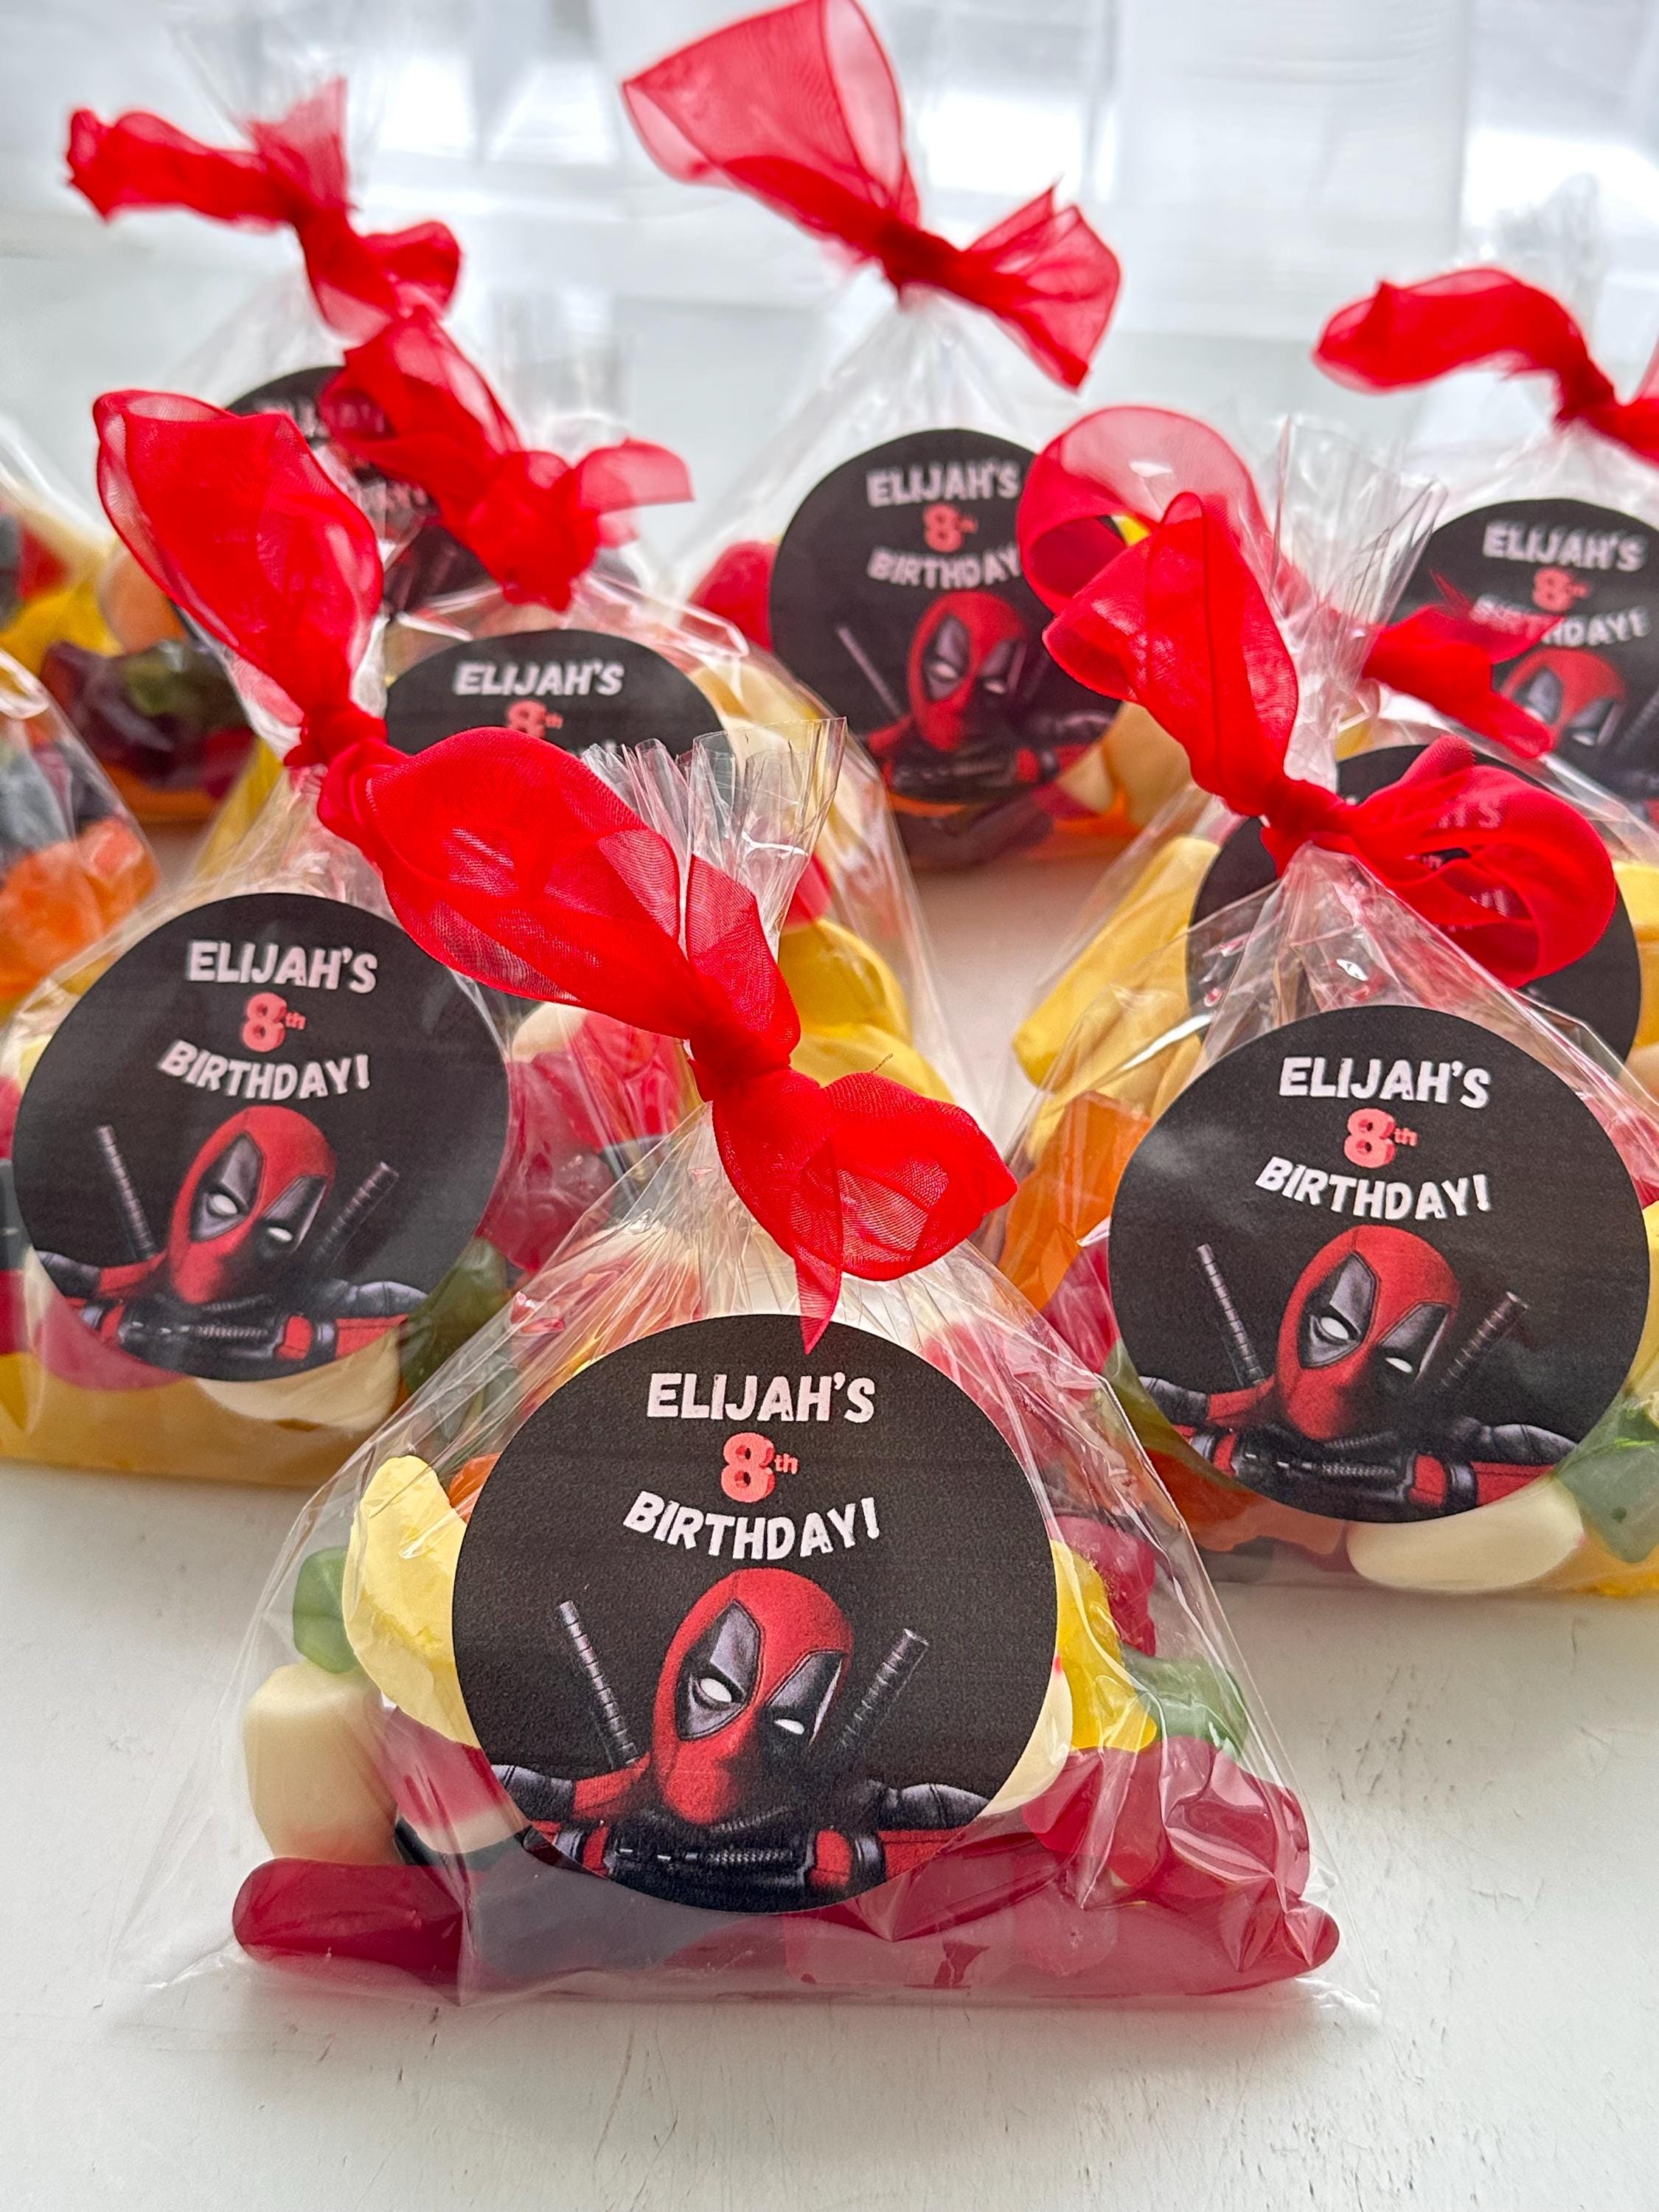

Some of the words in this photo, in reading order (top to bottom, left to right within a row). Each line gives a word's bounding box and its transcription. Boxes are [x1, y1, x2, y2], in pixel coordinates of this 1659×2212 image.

[866, 458, 1020, 507] ELIJAH'S
[867, 544, 1021, 589] BIRTHDAY
[1482, 520, 1647, 572] ELIJAH'S
[453, 659, 625, 696] ELIJAH'S
[188, 940, 378, 993] ELIJAH'S
[241, 992, 306, 1052] 8th
[159, 1040, 370, 1100] BIRTHDAY!
[1279, 1057, 1492, 1108] ELIJAH'S
[1343, 1107, 1419, 1169] 8th
[1255, 1156, 1491, 1220] BIRTHDAY!
[647, 1371, 876, 1424] ELIJAH'S
[720, 1431, 799, 1503] 8th
[622, 1490, 880, 1560] BIRTHDAY!
